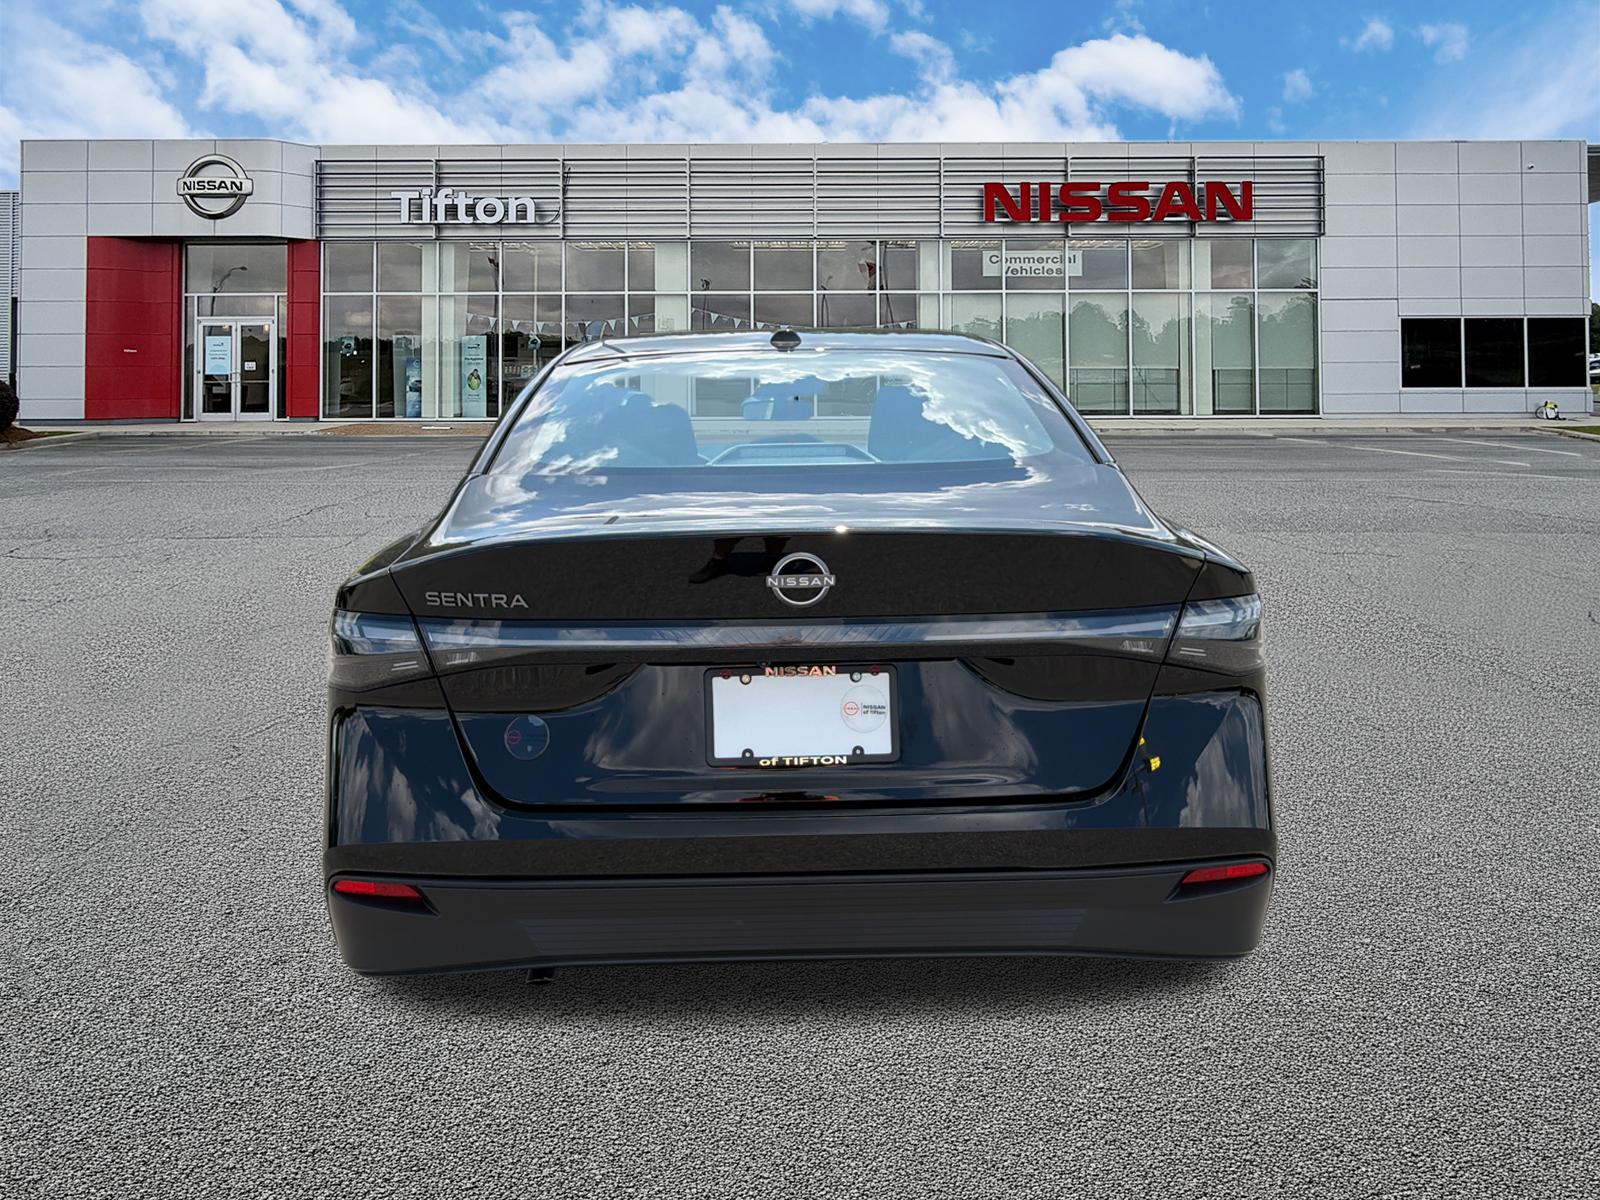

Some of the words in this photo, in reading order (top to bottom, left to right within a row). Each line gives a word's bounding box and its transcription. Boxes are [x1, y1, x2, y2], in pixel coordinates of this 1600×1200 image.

[183, 181, 243, 191] NISSAN
[391, 188, 536, 223] Tifton
[984, 181, 1253, 222] NISSAN
[768, 576, 834, 587] NISSAN
[425, 591, 529, 608] SENTRA
[764, 665, 837, 677] NISSAN
[759, 756, 779, 766] of
[782, 756, 847, 765] TIFTON
